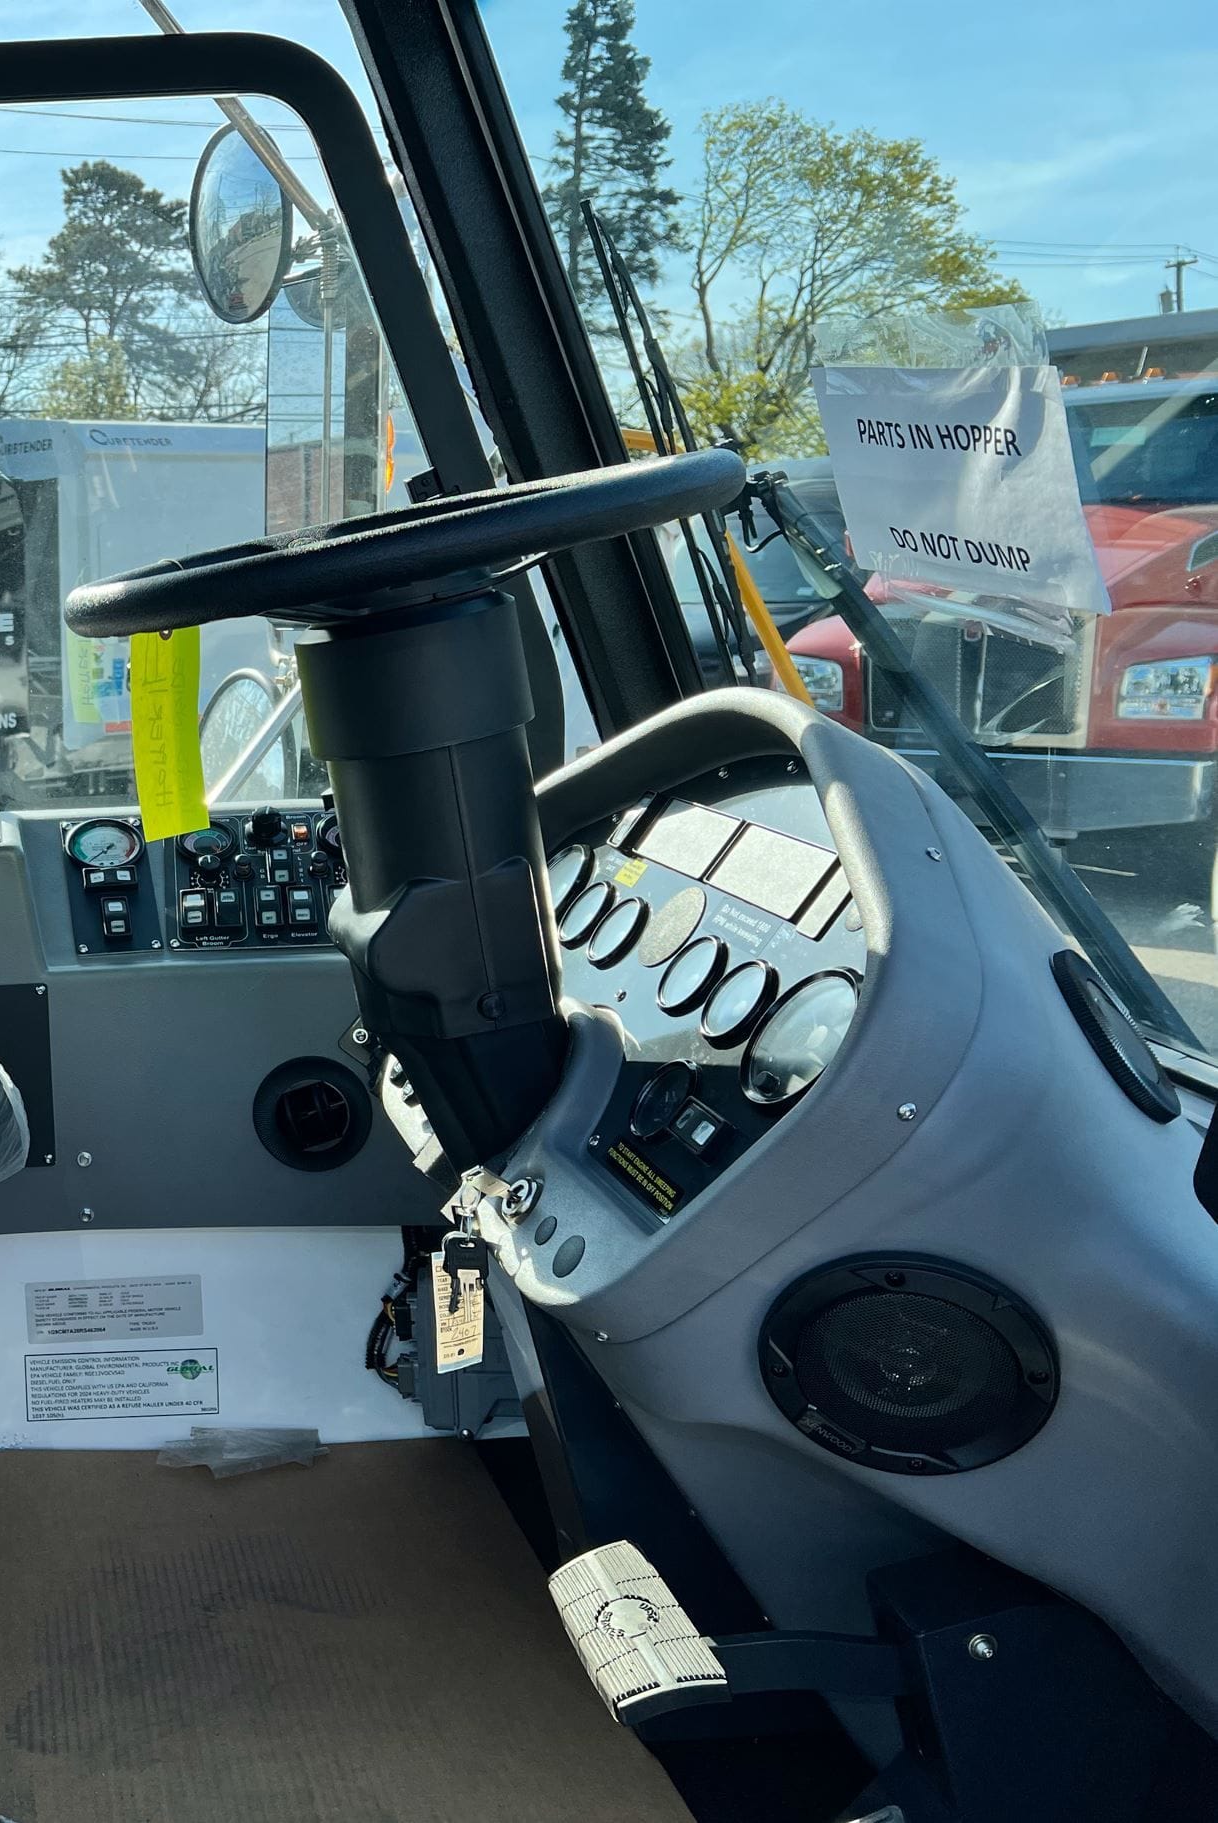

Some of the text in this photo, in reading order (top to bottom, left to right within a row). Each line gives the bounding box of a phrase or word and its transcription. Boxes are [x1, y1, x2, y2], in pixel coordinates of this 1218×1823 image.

[857, 418, 1022, 456] PARTS IN HOPPER
[889, 527, 1030, 572] DO NOT DUMP
[608, 1147, 629, 1168] FUNCTIONS
[627, 1164, 638, 1177] MUST
[636, 1174, 644, 1182] BE
[646, 1183, 656, 1193] OFF
[653, 1190, 674, 1210] POSITION
[618, 1142, 676, 1198] TO START ENGINE ALL SWEEPING
[803, 1416, 854, 1455] KENWOOD
